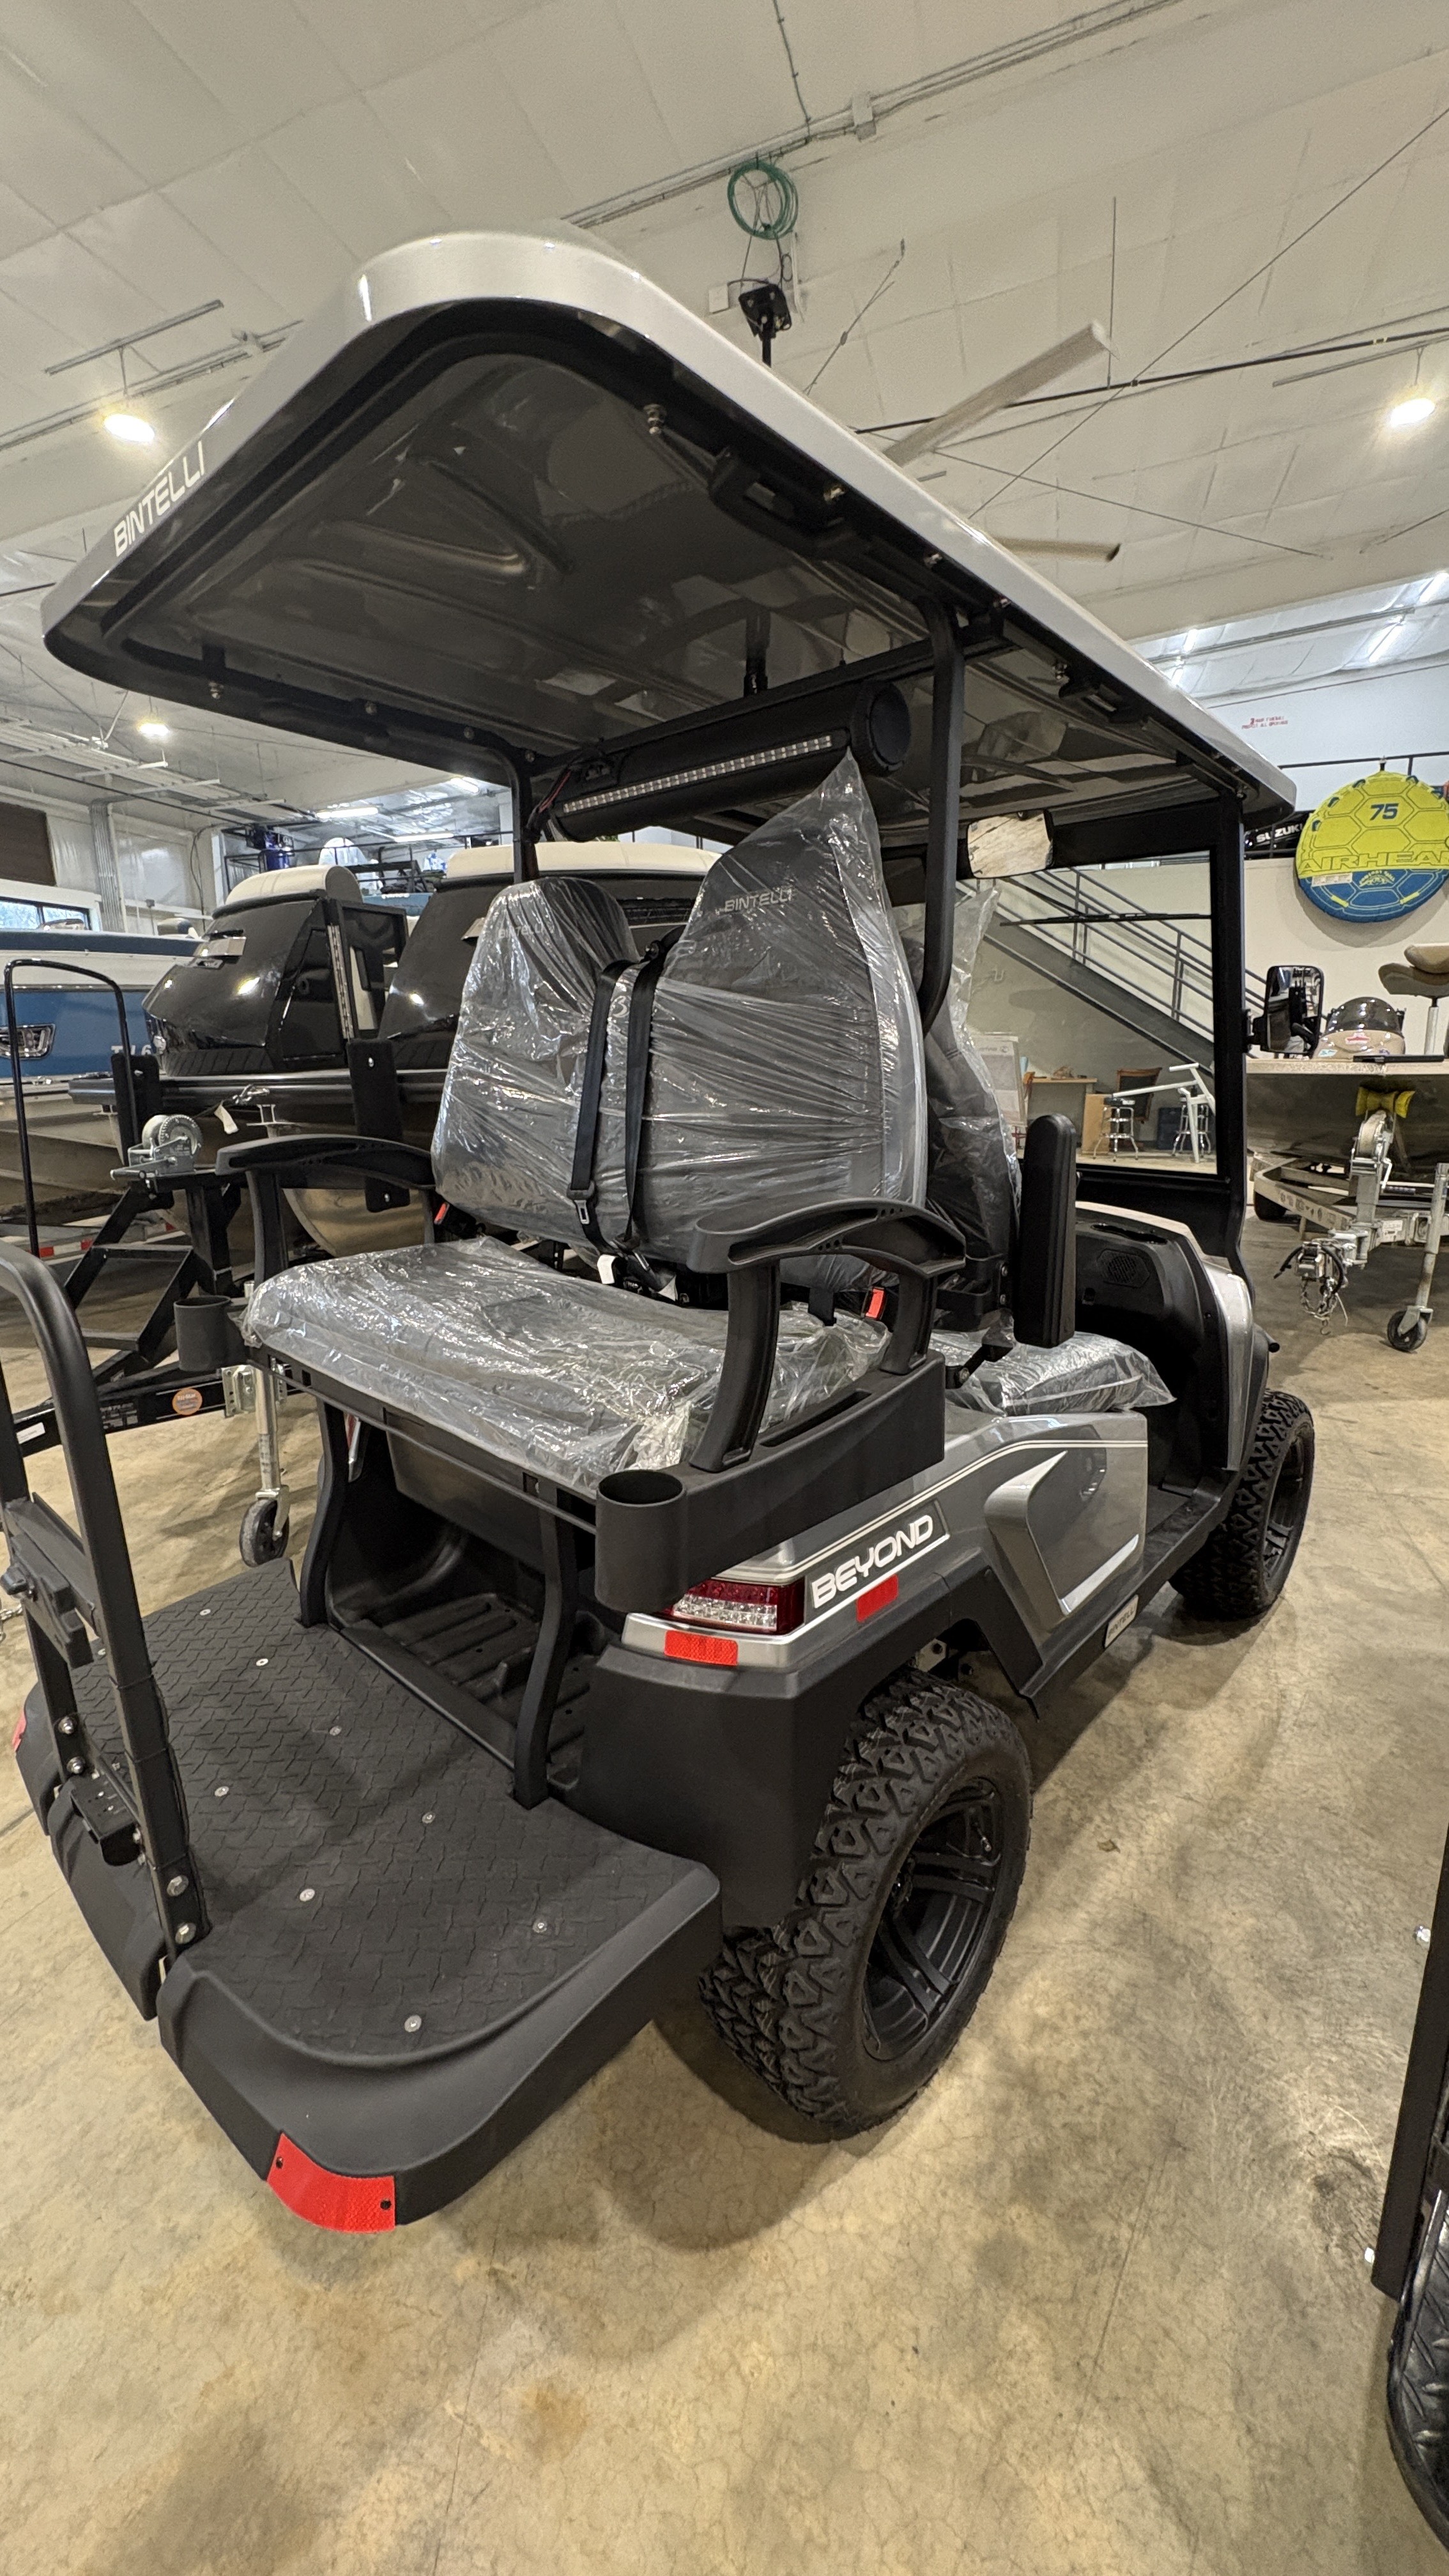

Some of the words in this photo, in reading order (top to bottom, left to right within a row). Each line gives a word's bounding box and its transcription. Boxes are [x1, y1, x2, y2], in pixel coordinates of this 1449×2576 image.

[114, 440, 204, 557] BINTELLI
[1369, 802, 1399, 821] 75
[724, 887, 792, 912] BINTELLI
[811, 1515, 933, 1609] BEYOND
